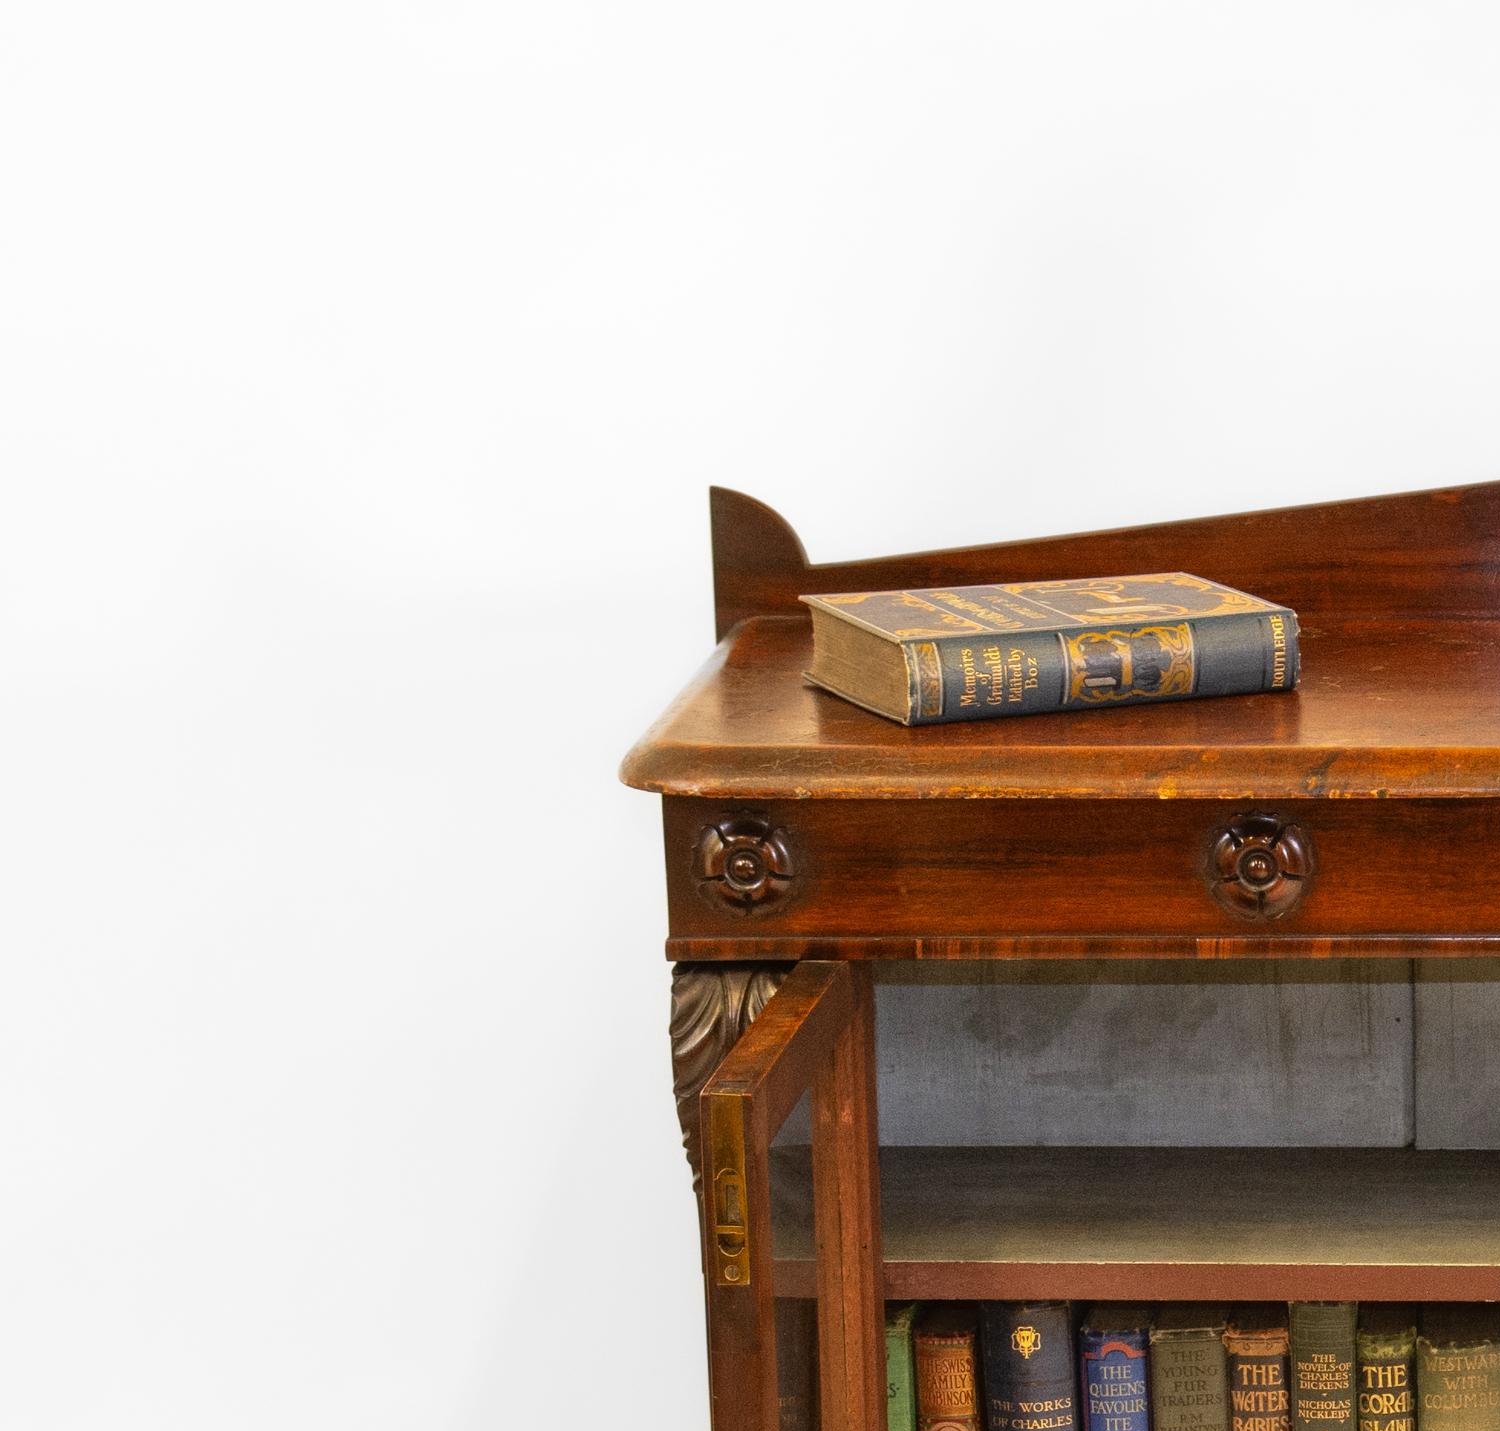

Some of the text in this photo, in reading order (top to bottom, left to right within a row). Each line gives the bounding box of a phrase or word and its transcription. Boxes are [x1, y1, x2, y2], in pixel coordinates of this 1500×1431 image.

[1270, 615, 1286, 688] ROUTLEDGE
[959, 648, 977, 707] Memoirs
[975, 671, 992, 685] of
[983, 645, 1003, 706] Grimaldi
[1024, 656, 1039, 689] Boz
[1171, 1350, 1206, 1363] THE
[1311, 1354, 1336, 1363] THE
[1100, 1365, 1132, 1380] THE
[1161, 1366, 1218, 1378] YOUNG
[1237, 1363, 1284, 1386] THE
[1362, 1363, 1408, 1389] THE
[925, 1374, 968, 1389] FAMILY
[1173, 1380, 1207, 1393] FUR
[1299, 1381, 1349, 1391] DICKENS
[1443, 1375, 1489, 1391] WITH
[921, 1389, 973, 1406] ROBINSON
[992, 1397, 1072, 1413] THE WORKS
[1159, 1393, 1223, 1407] TRADERS
[1231, 1390, 1289, 1412] WATER
[1359, 1391, 1415, 1415] CORAL
[1297, 1400, 1351, 1411] NICHOLAS
[993, 1415, 1074, 1430] OF CHARLES
[1297, 1410, 1351, 1420] NICKLEBY
[1105, 1417, 1133, 1431] ITE
